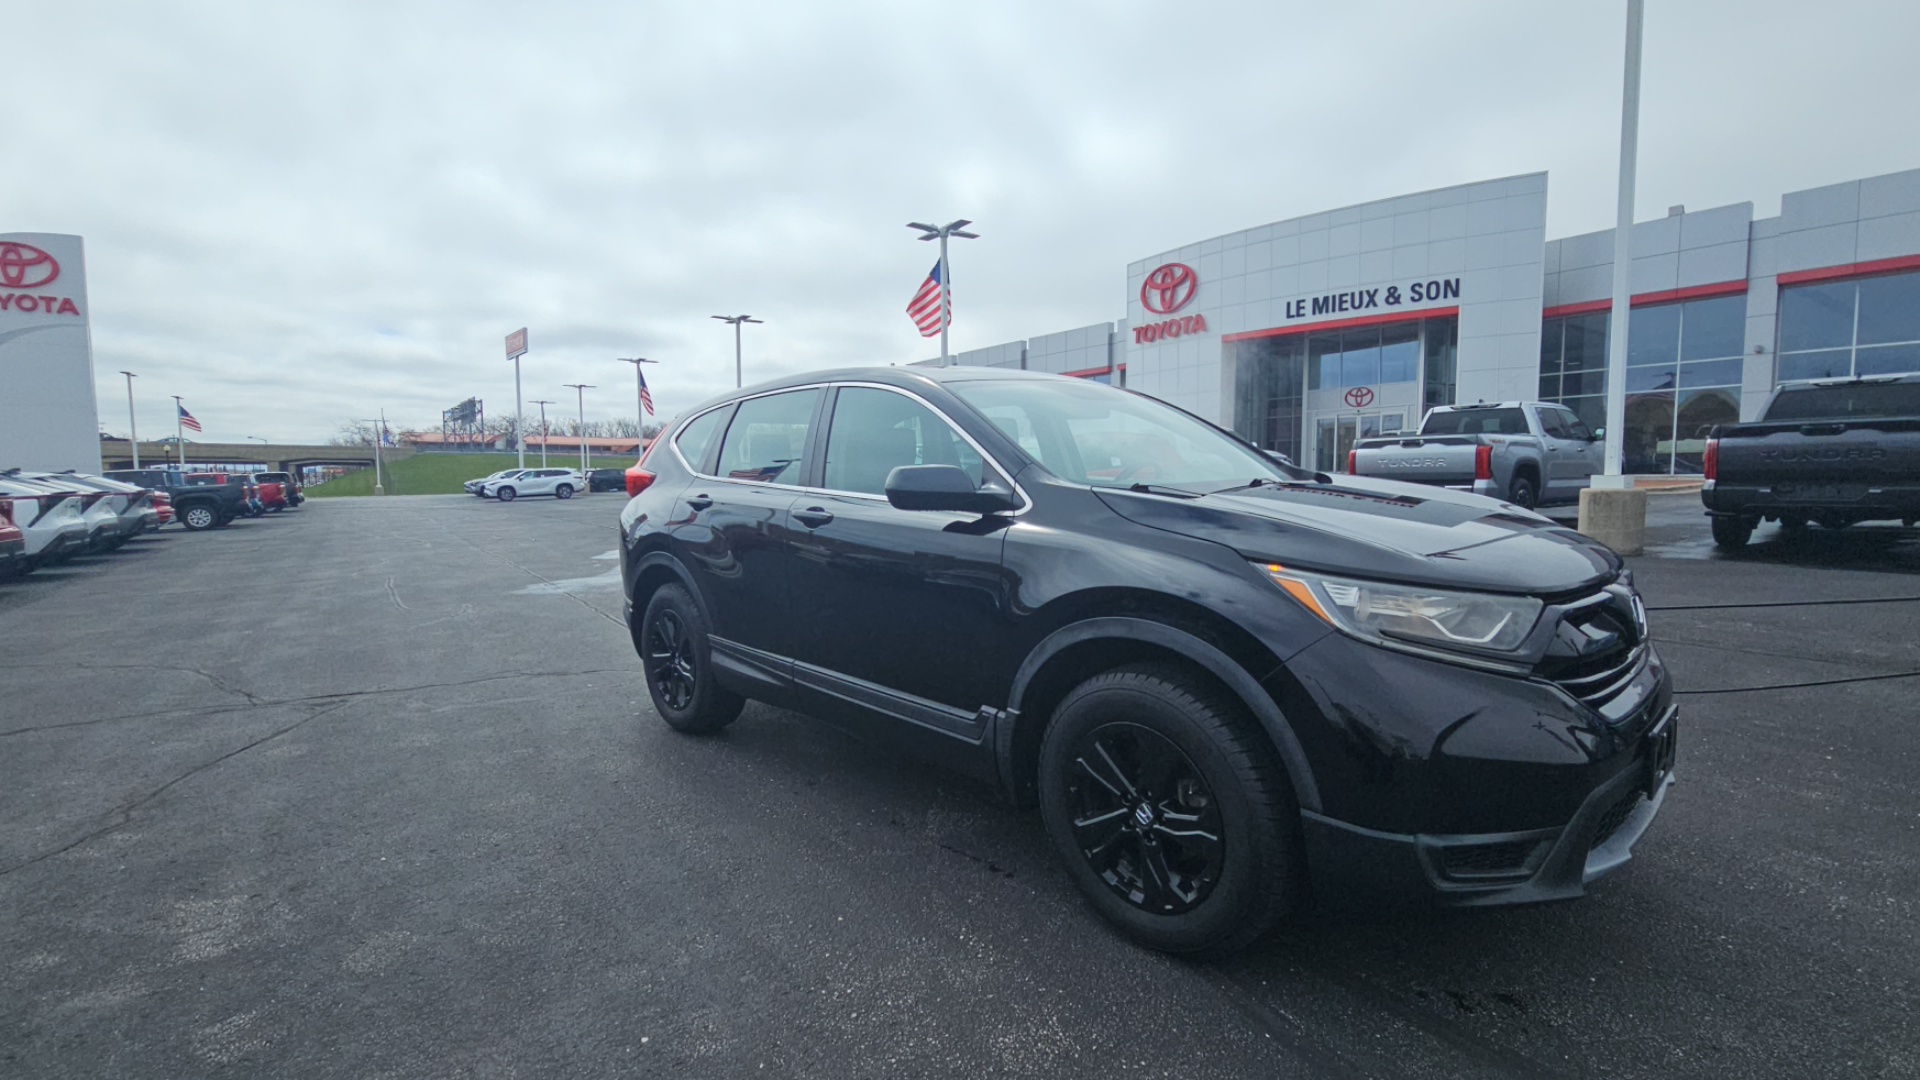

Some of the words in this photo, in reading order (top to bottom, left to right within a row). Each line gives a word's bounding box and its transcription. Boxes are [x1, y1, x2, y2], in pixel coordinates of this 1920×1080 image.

[1286, 299, 1306, 319] LE
[1312, 288, 1379, 316] MIEUX
[1384, 285, 1402, 306] &
[1410, 278, 1460, 303] SON
[1132, 313, 1207, 344] TOYOTA
[1378, 458, 1447, 468] TUNDRA
[1760, 449, 1887, 462] TUNDRA
